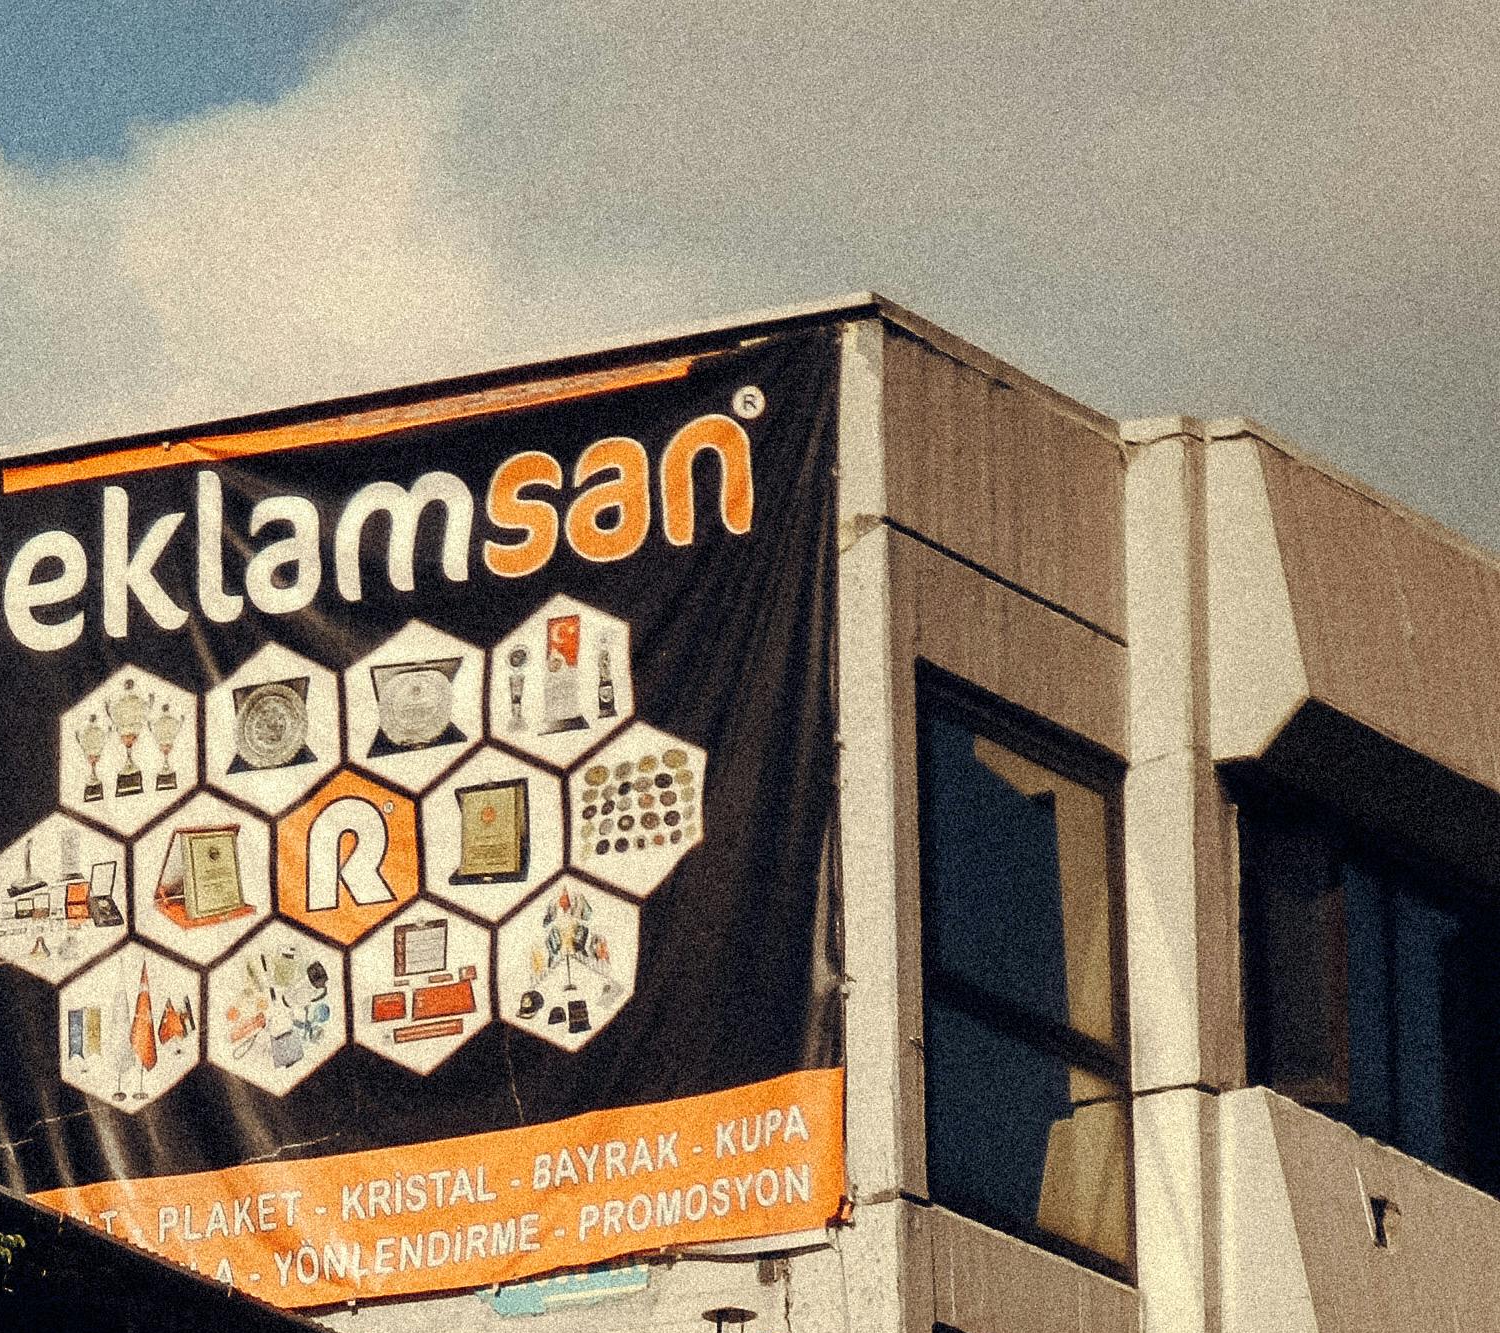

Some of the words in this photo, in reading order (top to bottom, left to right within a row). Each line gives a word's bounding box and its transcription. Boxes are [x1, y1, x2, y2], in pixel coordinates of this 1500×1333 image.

[306, 795, 397, 912] R
[158, 1189, 303, 1244] PLAKET
[341, 1164, 497, 1222] KRİSTAL
[533, 1131, 680, 1191] BAYRAK
[715, 1104, 810, 1160] KUPA
[274, 1212, 542, 1289] YÖNLENDİRME
[578, 1163, 812, 1242] PROMOSYON
